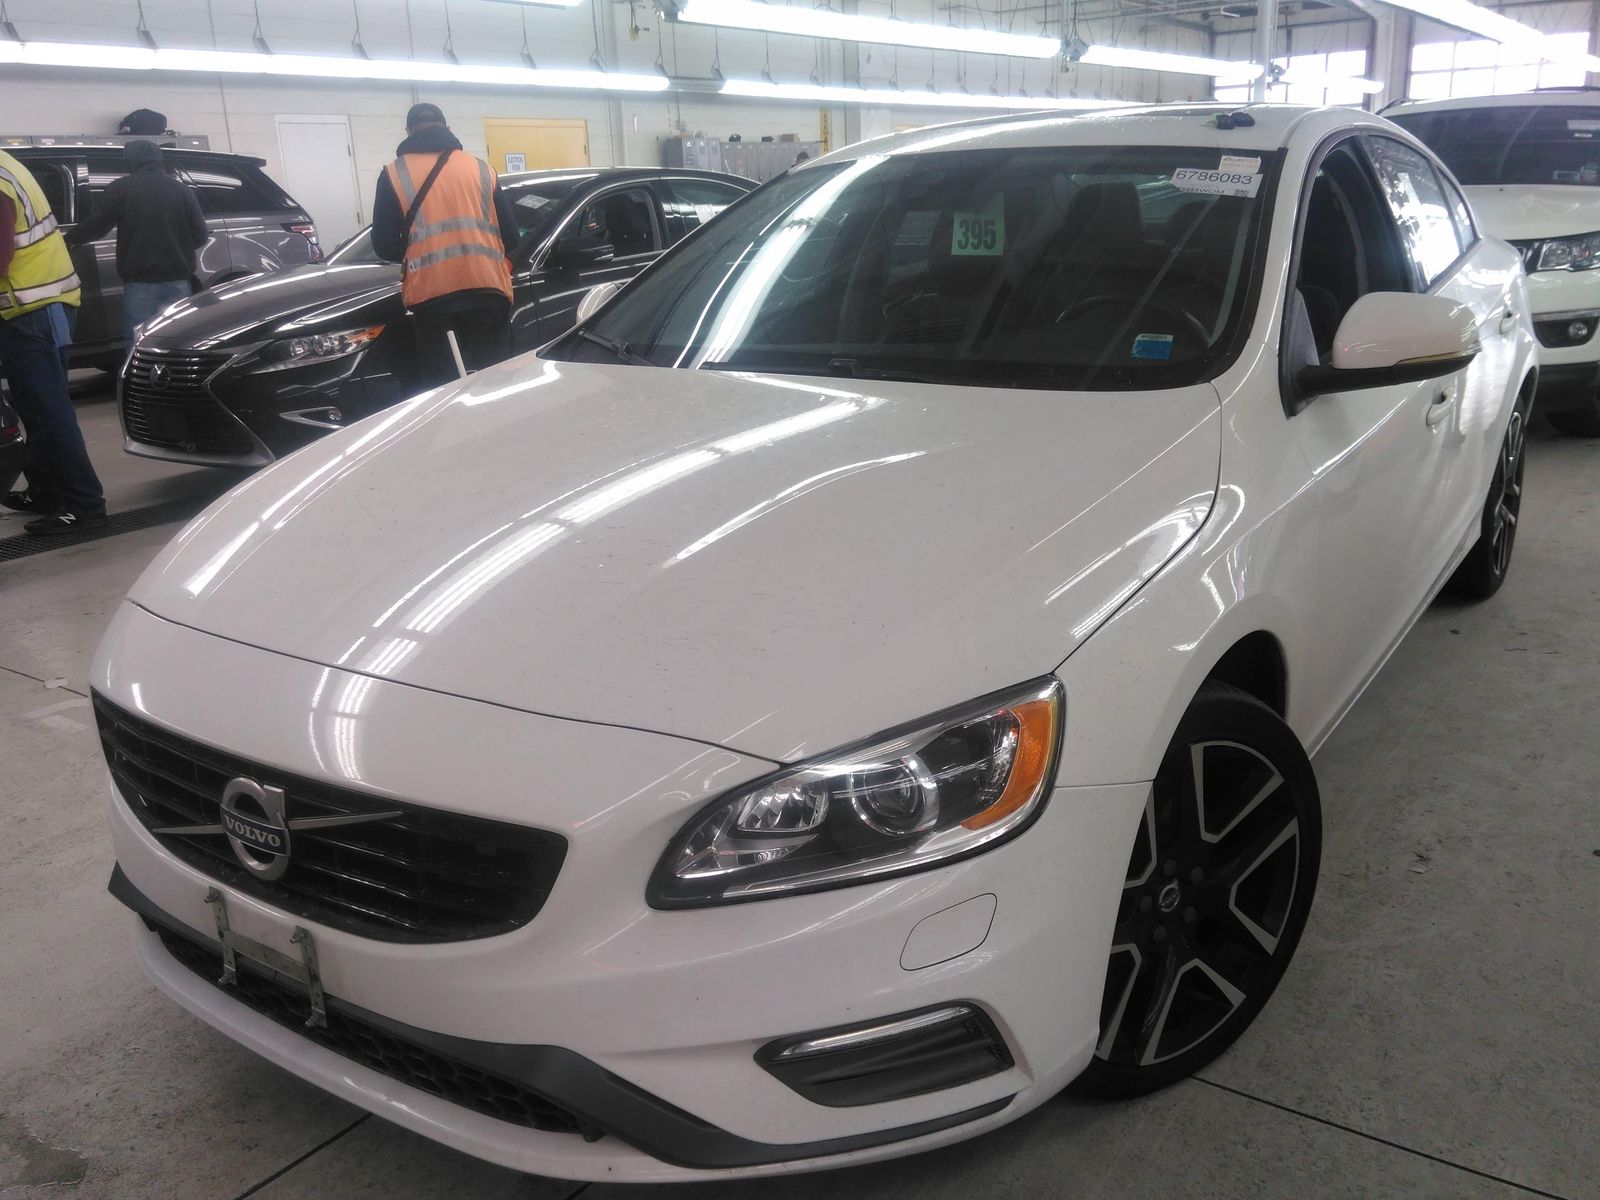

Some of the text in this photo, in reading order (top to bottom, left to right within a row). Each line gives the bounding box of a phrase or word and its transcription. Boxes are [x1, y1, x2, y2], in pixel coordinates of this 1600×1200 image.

[1176, 170, 1253, 185] 6786083
[957, 220, 997, 250] 395
[223, 814, 281, 847] VOLVO
